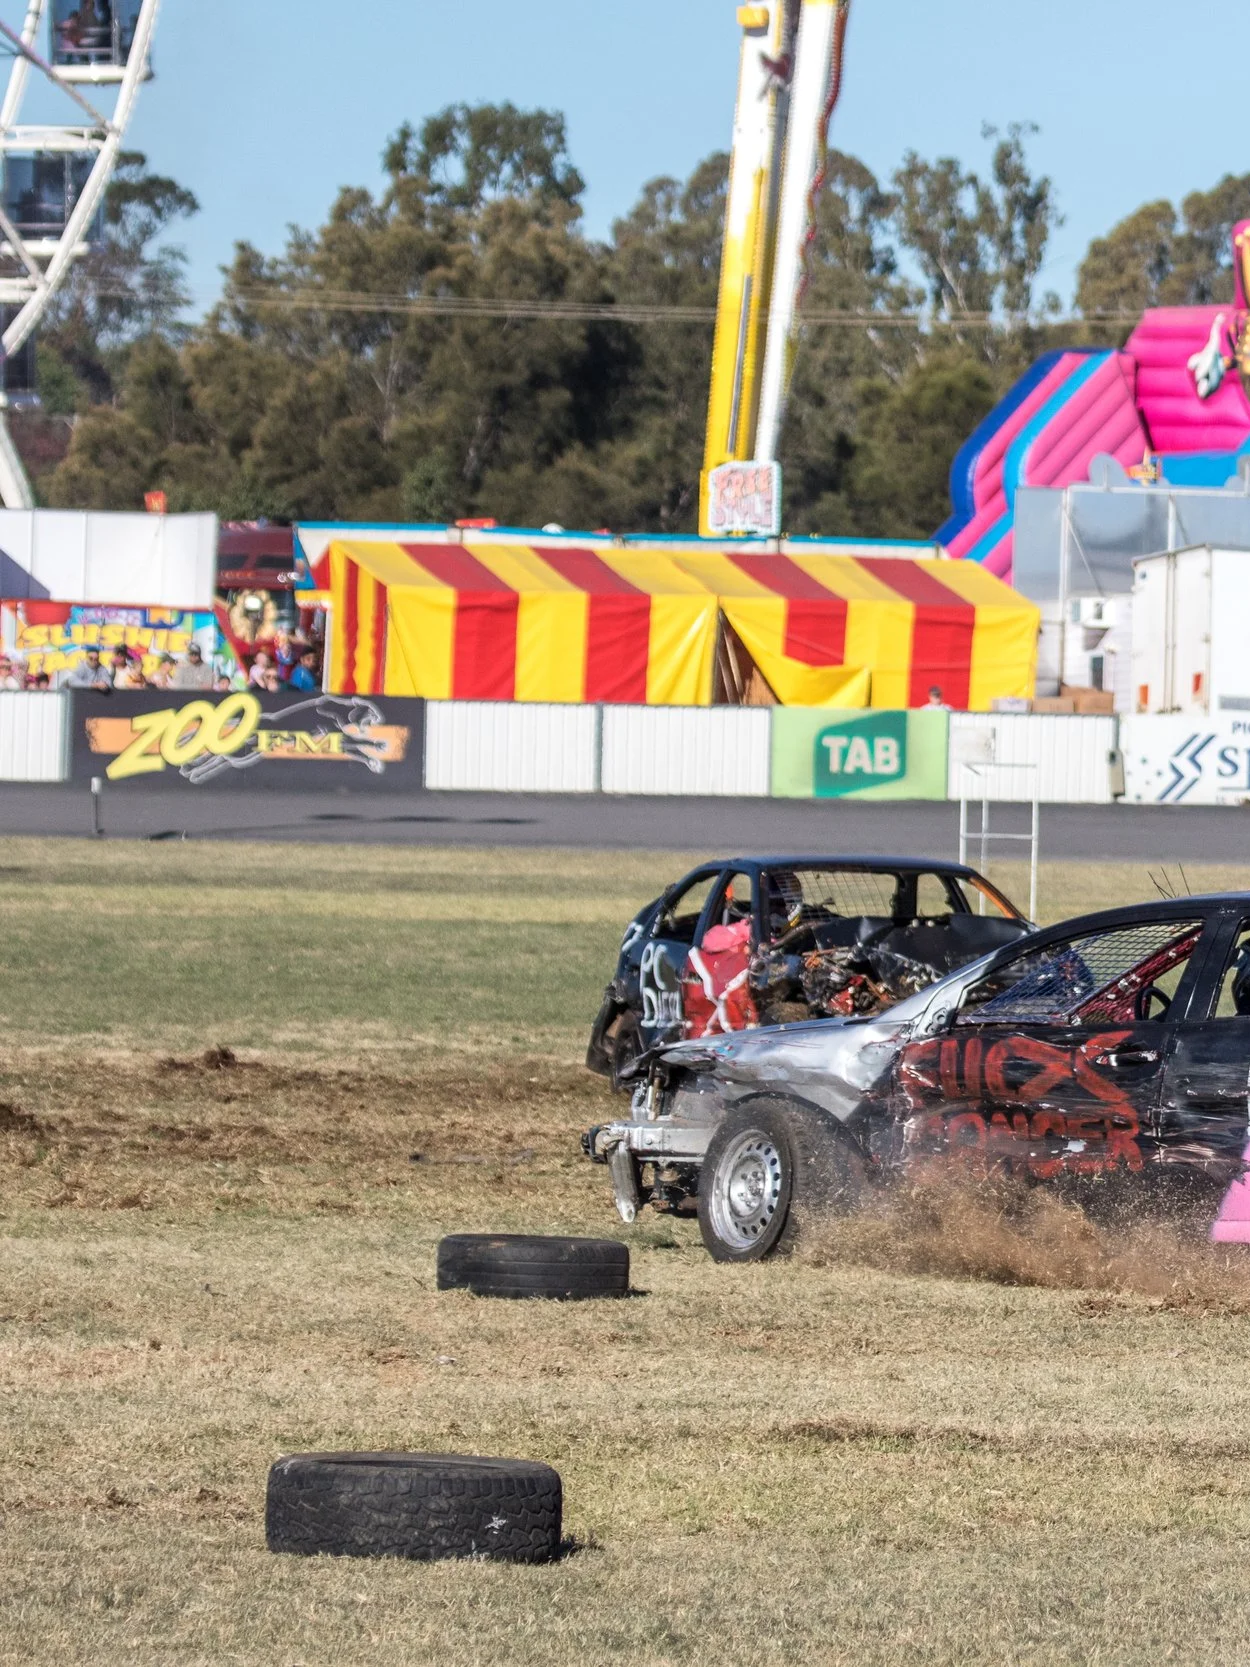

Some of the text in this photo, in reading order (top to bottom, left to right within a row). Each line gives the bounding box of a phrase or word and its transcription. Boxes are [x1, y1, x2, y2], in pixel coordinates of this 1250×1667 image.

[22, 623, 193, 653] SLUSHIE
[105, 691, 345, 780] ZOO FM
[821, 735, 899, 774] TAB
[900, 1030, 1134, 1107] FUCK
